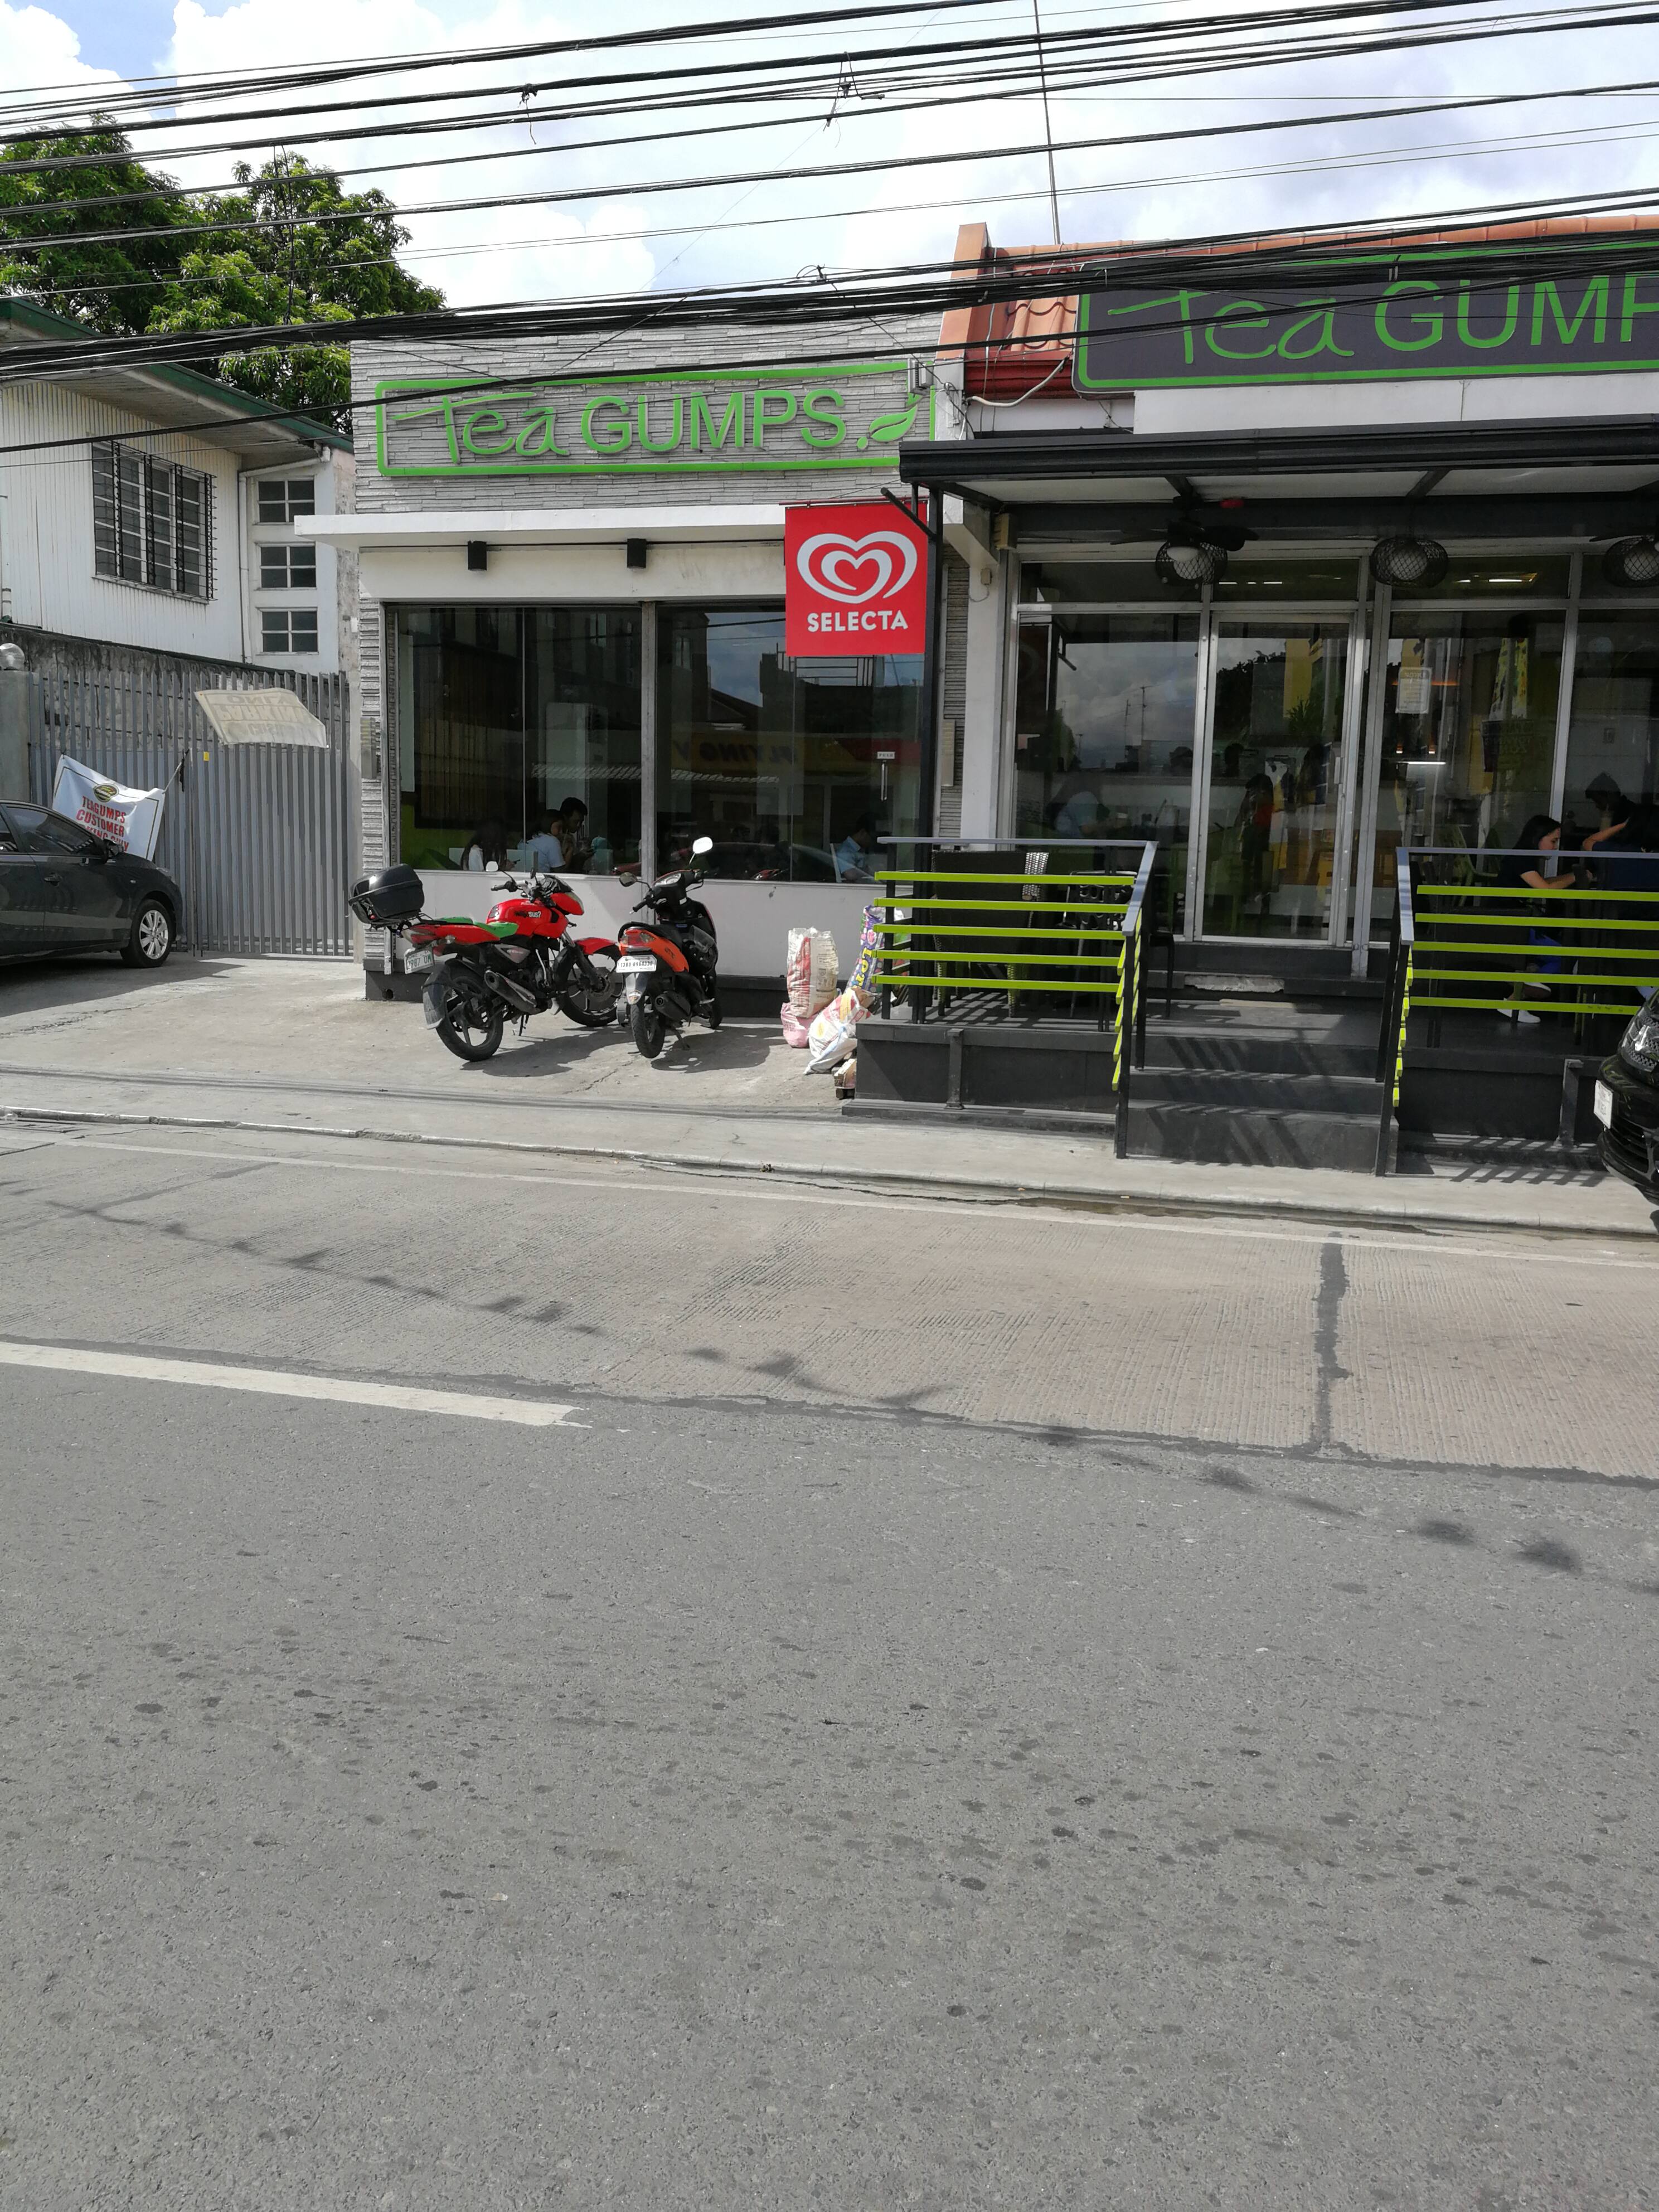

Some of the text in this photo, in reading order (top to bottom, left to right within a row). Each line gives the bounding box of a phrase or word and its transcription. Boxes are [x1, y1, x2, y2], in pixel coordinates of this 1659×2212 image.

[1107, 289, 1355, 364] Tea
[390, 391, 570, 464] Tea
[807, 609, 909, 633] SELECTA
[76, 809, 125, 837] CUSTOMER
